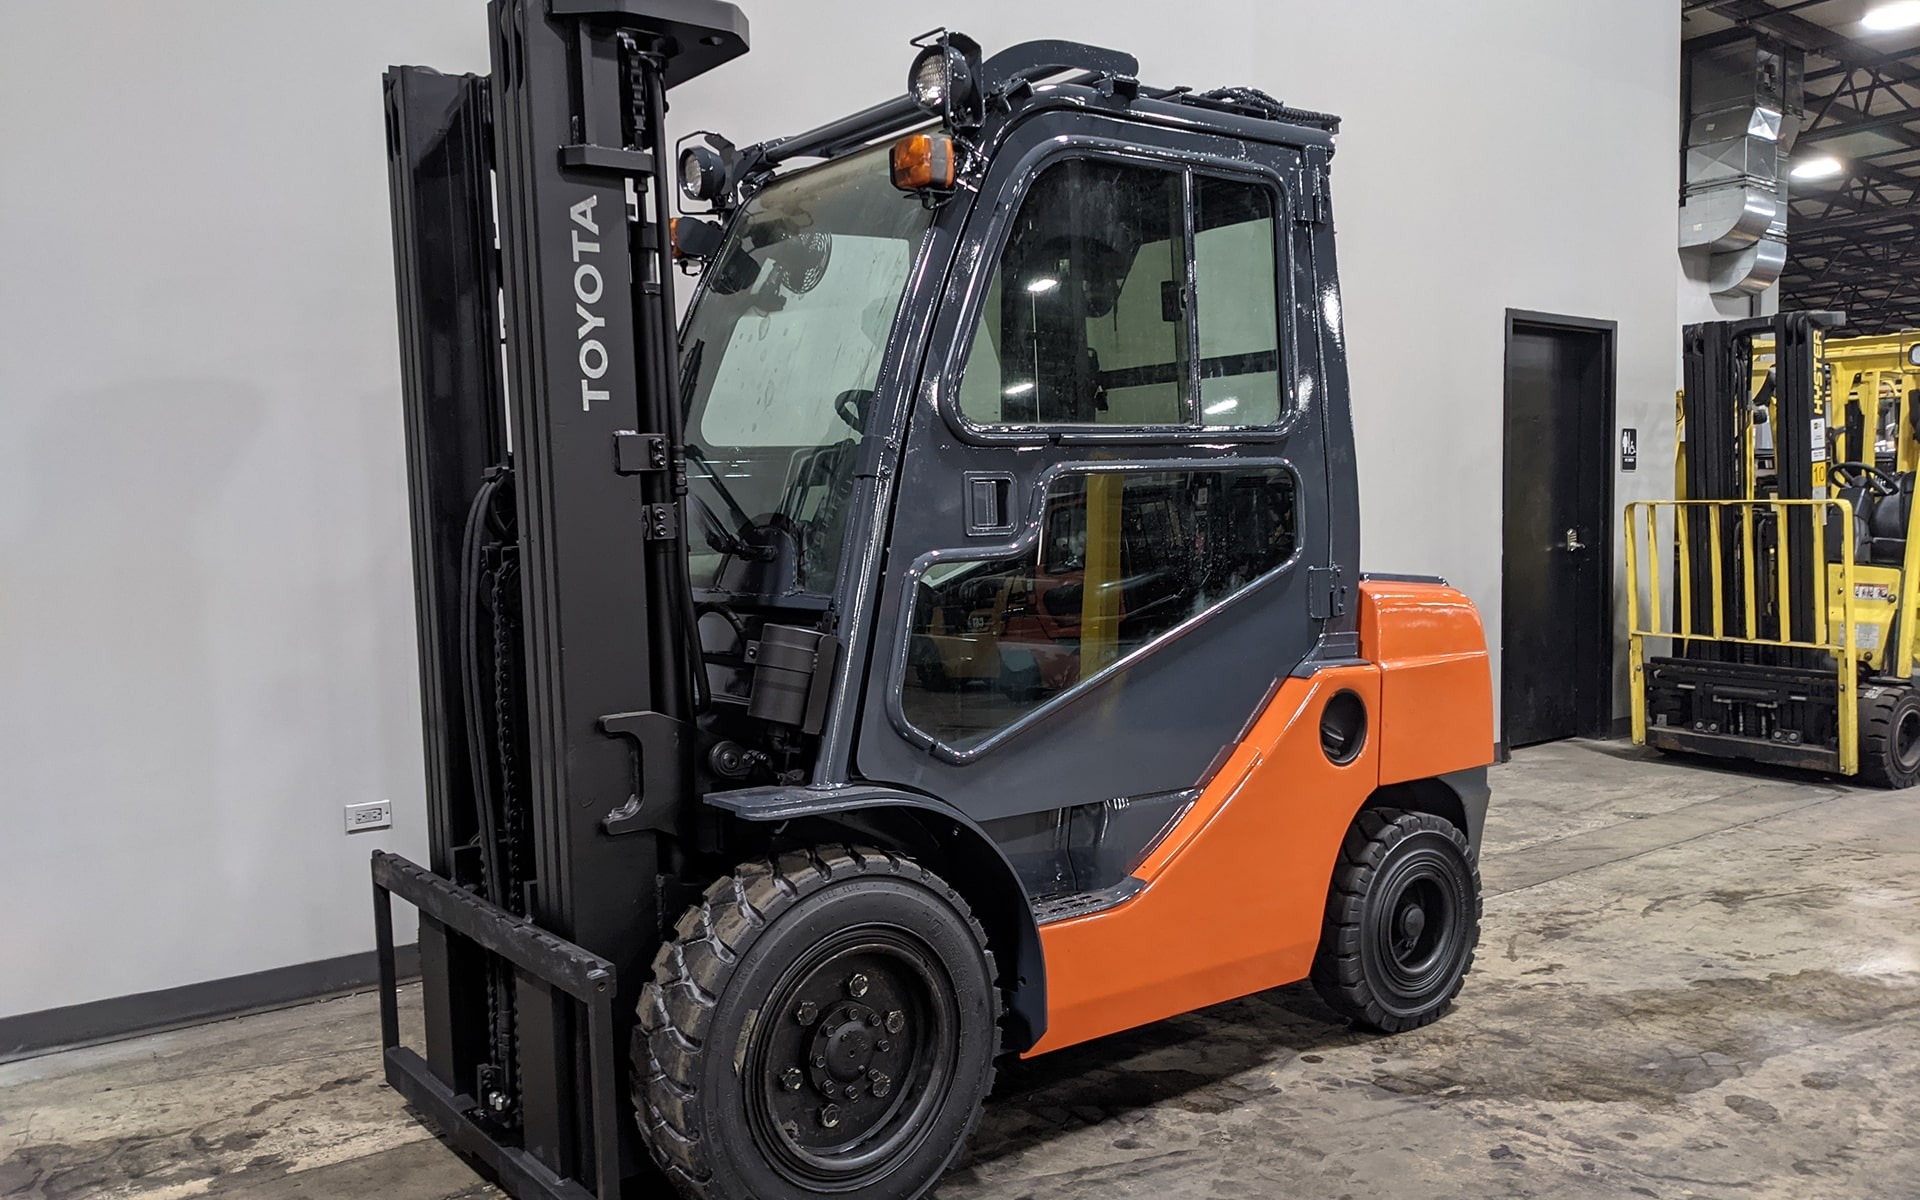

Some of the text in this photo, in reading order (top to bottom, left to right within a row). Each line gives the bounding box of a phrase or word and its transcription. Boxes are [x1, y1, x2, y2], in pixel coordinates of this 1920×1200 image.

[570, 194, 610, 412] TOYOTA
[1813, 329, 1823, 415] HYSTER
[1813, 465, 1825, 483] 10
